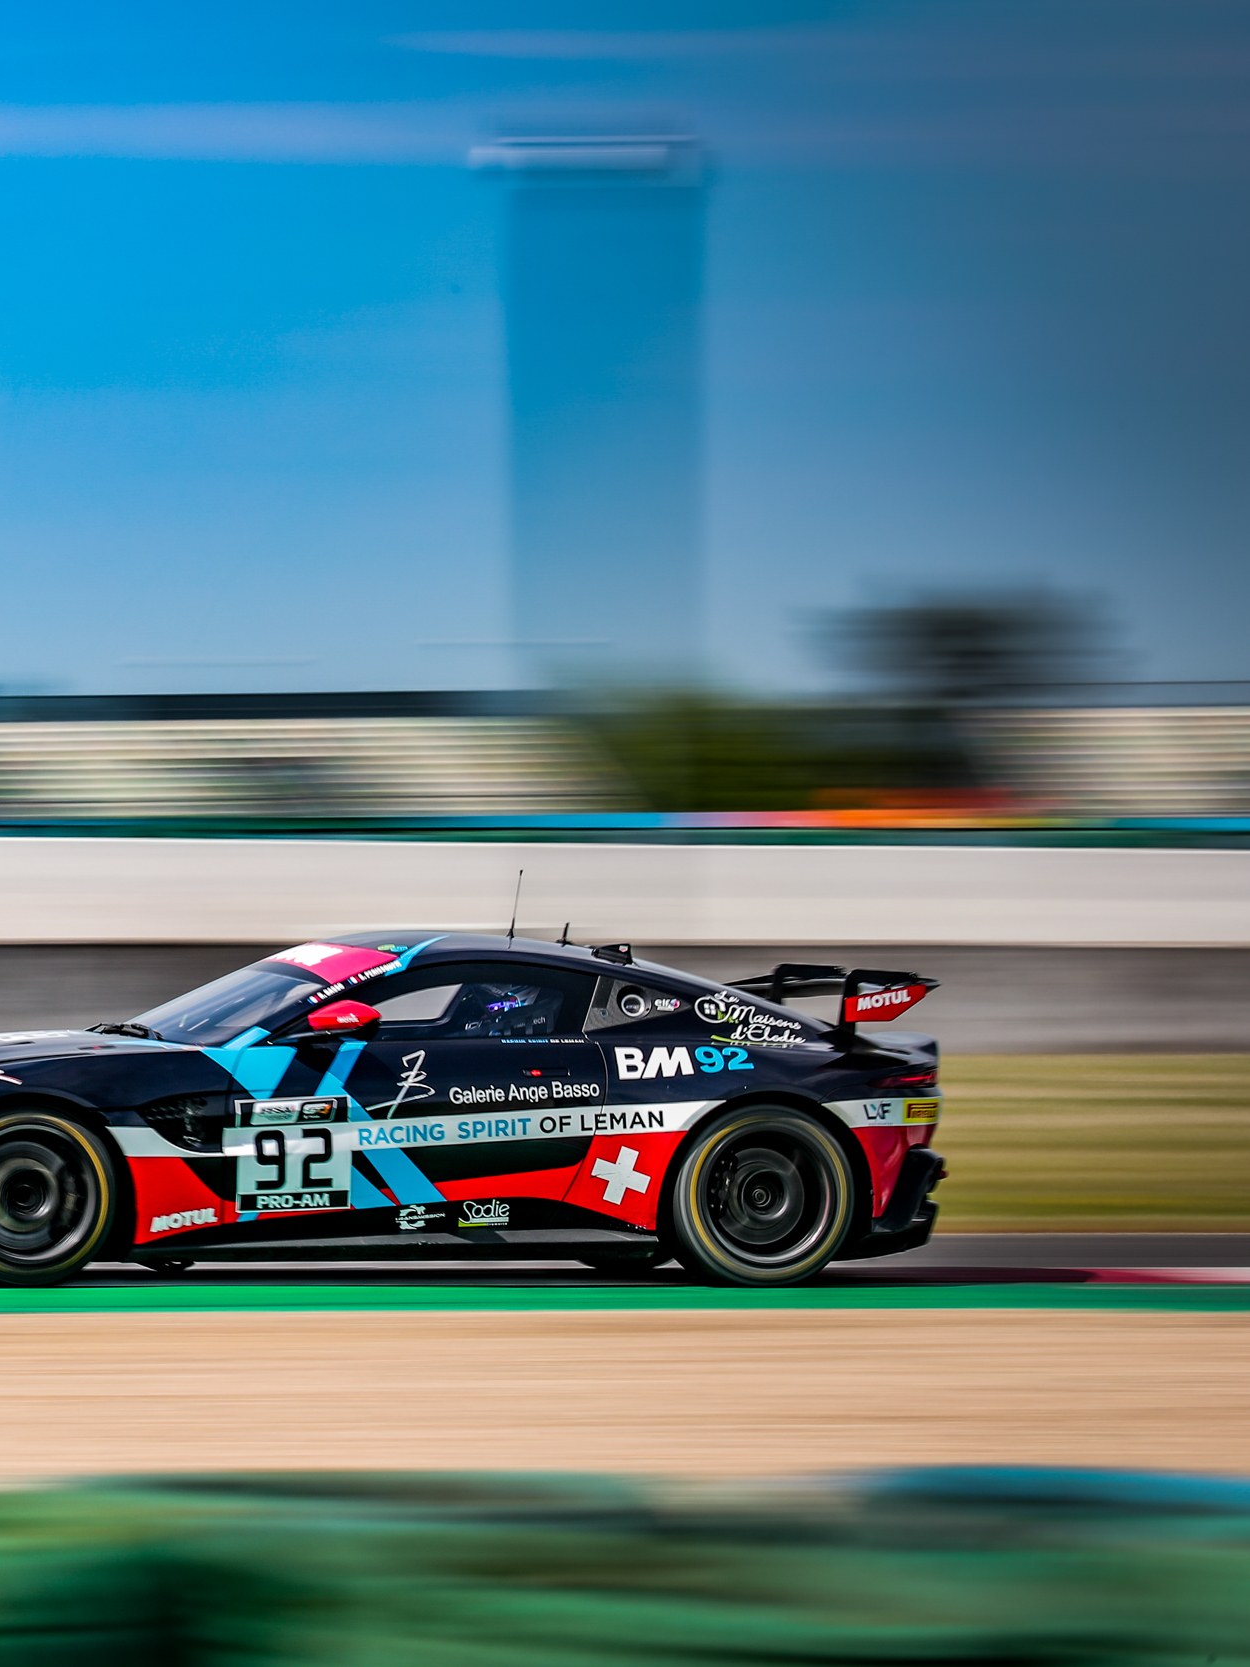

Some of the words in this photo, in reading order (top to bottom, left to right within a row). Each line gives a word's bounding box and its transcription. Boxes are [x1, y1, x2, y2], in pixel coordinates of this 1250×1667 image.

[857, 989, 912, 1012] MOTUL
[731, 1005, 802, 1030] Maisons
[448, 1083, 505, 1105] Galerie
[508, 1082, 549, 1104] Ange
[552, 1080, 600, 1099] Basso
[358, 1123, 446, 1146] RACING
[457, 1117, 532, 1139] SPIRIT
[539, 1115, 572, 1134] OF
[580, 1110, 665, 1132] LEMAN
[254, 1128, 334, 1190] 92
[256, 1192, 331, 1210] PRO-AM
[458, 1199, 510, 1224] Sodie
[150, 1207, 218, 1233] MOTUL
